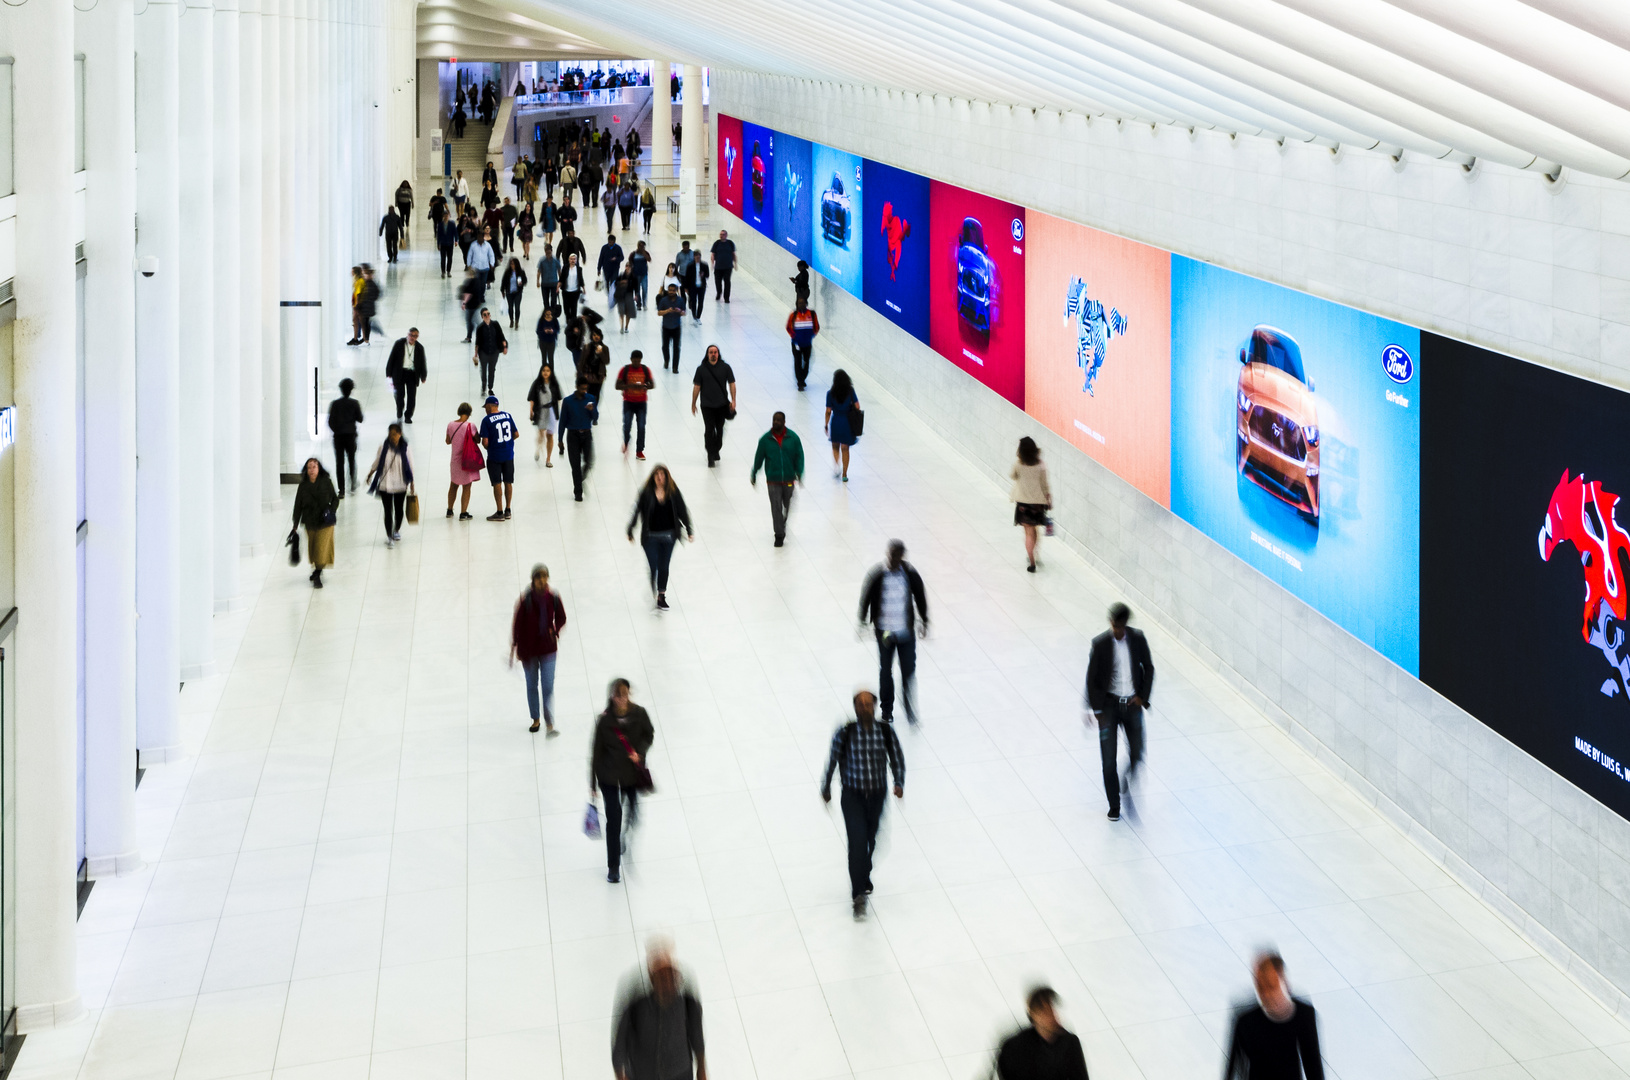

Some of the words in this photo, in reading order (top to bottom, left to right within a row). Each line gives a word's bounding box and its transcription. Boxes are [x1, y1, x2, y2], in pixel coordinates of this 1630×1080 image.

[495, 420, 512, 443] 13
[1574, 735, 1592, 758] MADE
[1592, 746, 1601, 763] BY
[1601, 752, 1615, 773] LUIS
